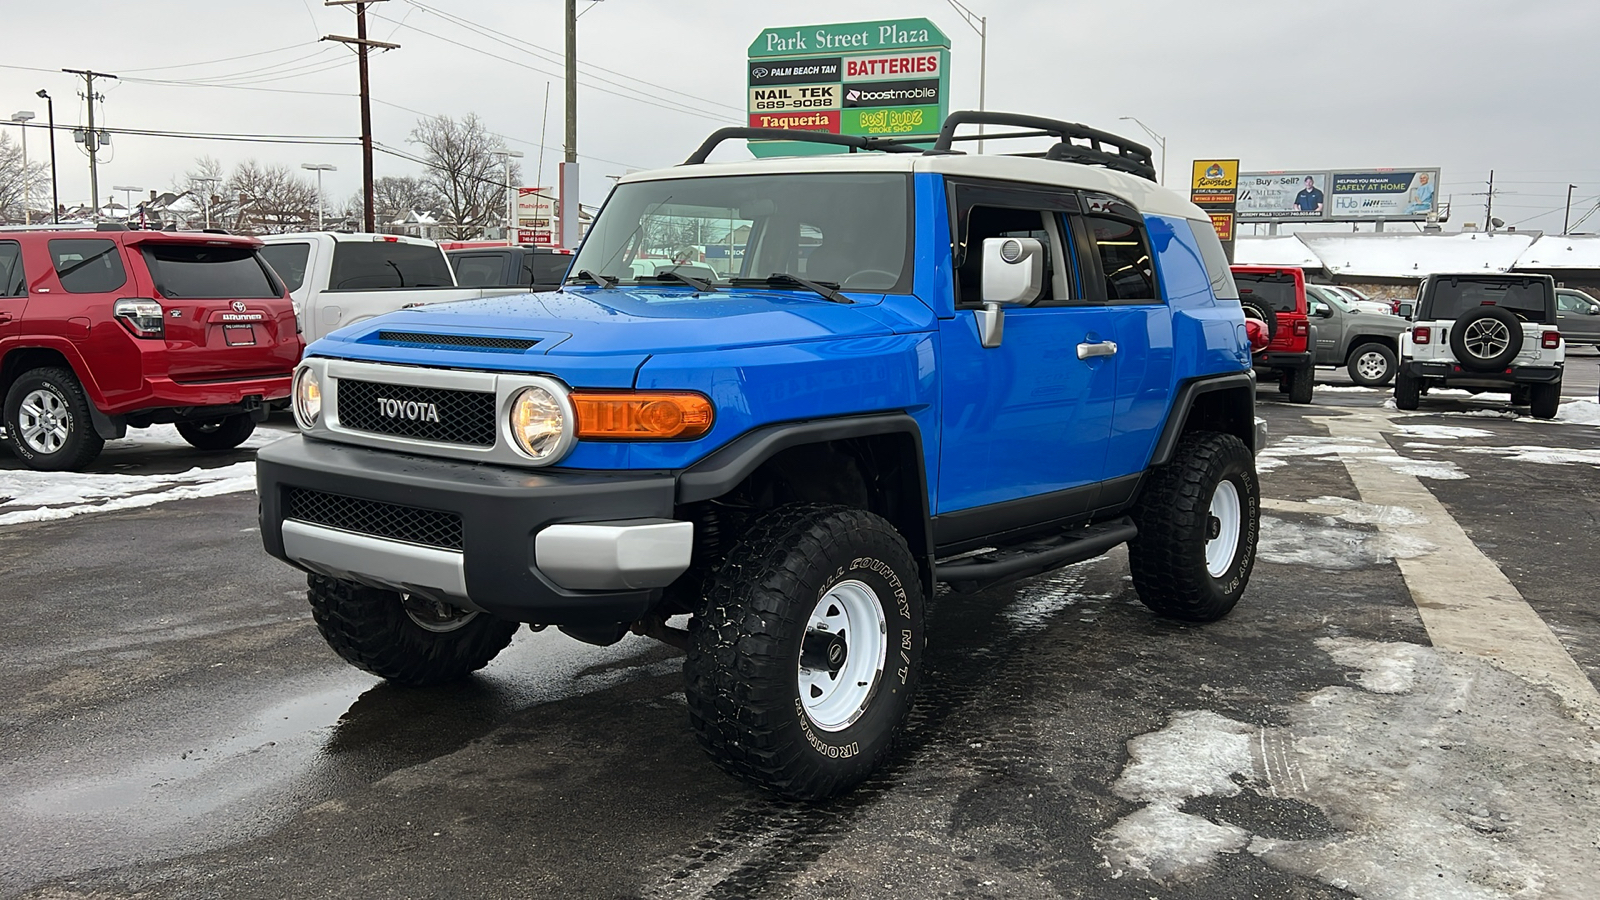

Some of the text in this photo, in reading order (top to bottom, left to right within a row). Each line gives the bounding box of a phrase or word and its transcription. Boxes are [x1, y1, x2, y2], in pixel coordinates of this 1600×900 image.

[766, 23, 929, 52] Park Street Plaza
[770, 64, 837, 77] PALM BEACH TAN
[847, 55, 937, 77] BATTERIES
[754, 86, 834, 101] NAIL TEK
[756, 98, 833, 110] 689-9088
[868, 125, 913, 134] SMOKE SHOP
[1197, 177, 1232, 188] Roosters
[1256, 178, 1272, 187] Buy
[1280, 177, 1300, 185] Sell?
[377, 397, 440, 423] TOYOTA
[849, 557, 911, 620] COUNTRY
[897, 629, 912, 685] M/T
